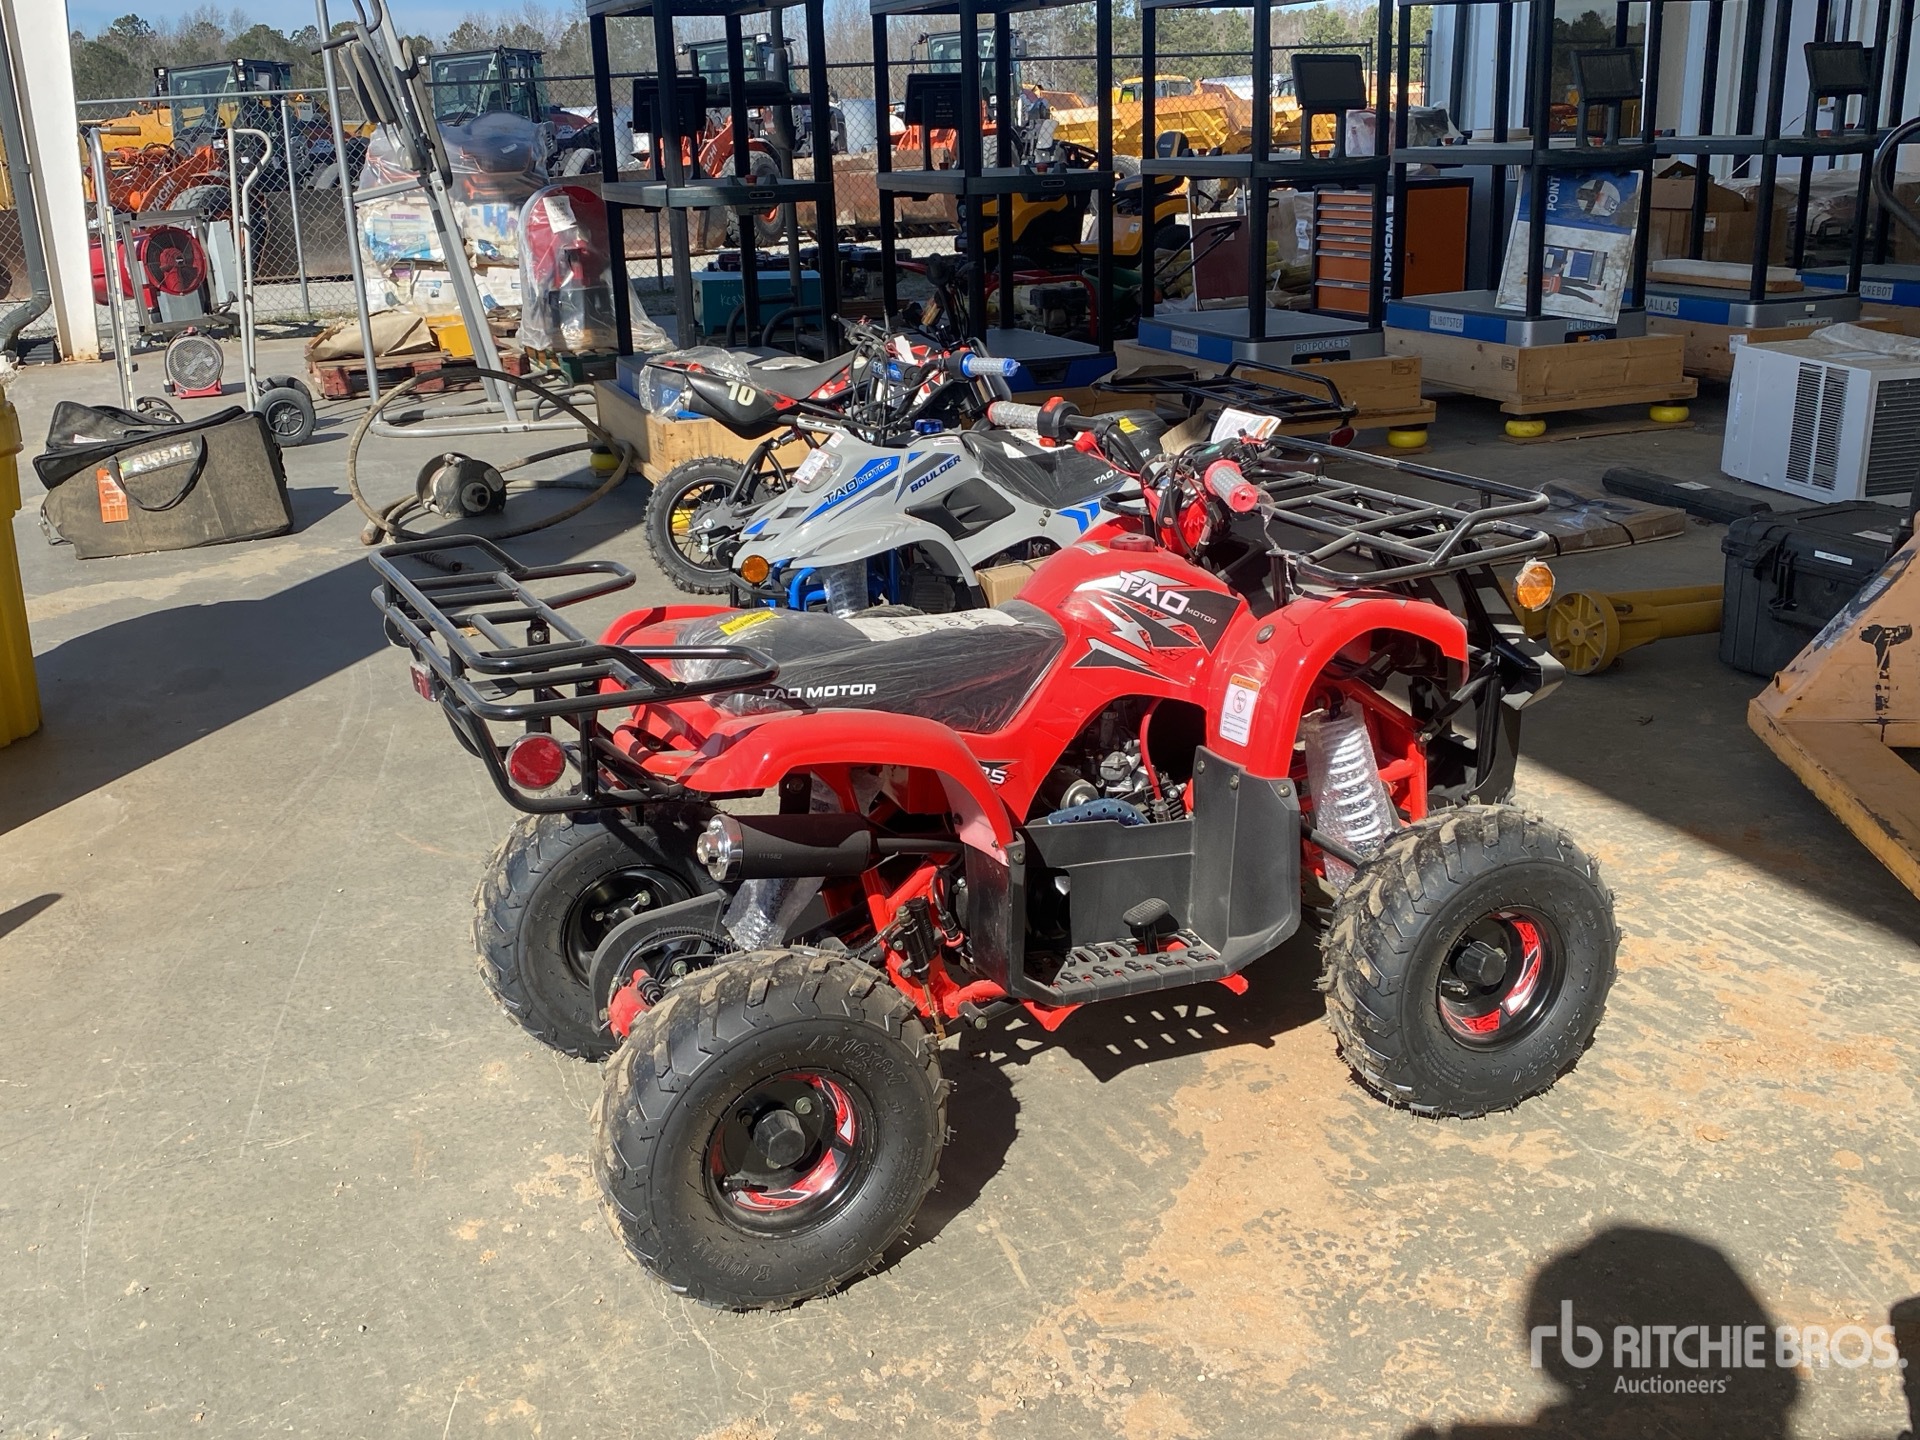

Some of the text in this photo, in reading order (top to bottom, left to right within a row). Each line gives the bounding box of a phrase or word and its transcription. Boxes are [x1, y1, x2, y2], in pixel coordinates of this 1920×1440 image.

[1547, 175, 1561, 211] POINT
[1383, 216, 1394, 282] WOKIN
[1860, 284, 1892, 297] OREBOT
[1430, 314, 1463, 329] FILIBOTSTER
[1295, 338, 1350, 352] BOTPOCKETS
[725, 380, 756, 406] 10
[132, 444, 193, 468] SUBSITE
[823, 475, 859, 504] TAO
[858, 458, 891, 486] MOTOR
[910, 454, 962, 494] BOULDER
[1093, 470, 1114, 485] TAO
[1118, 570, 1217, 625] TAO MOTOR
[763, 683, 877, 700] TAO MOTOR
